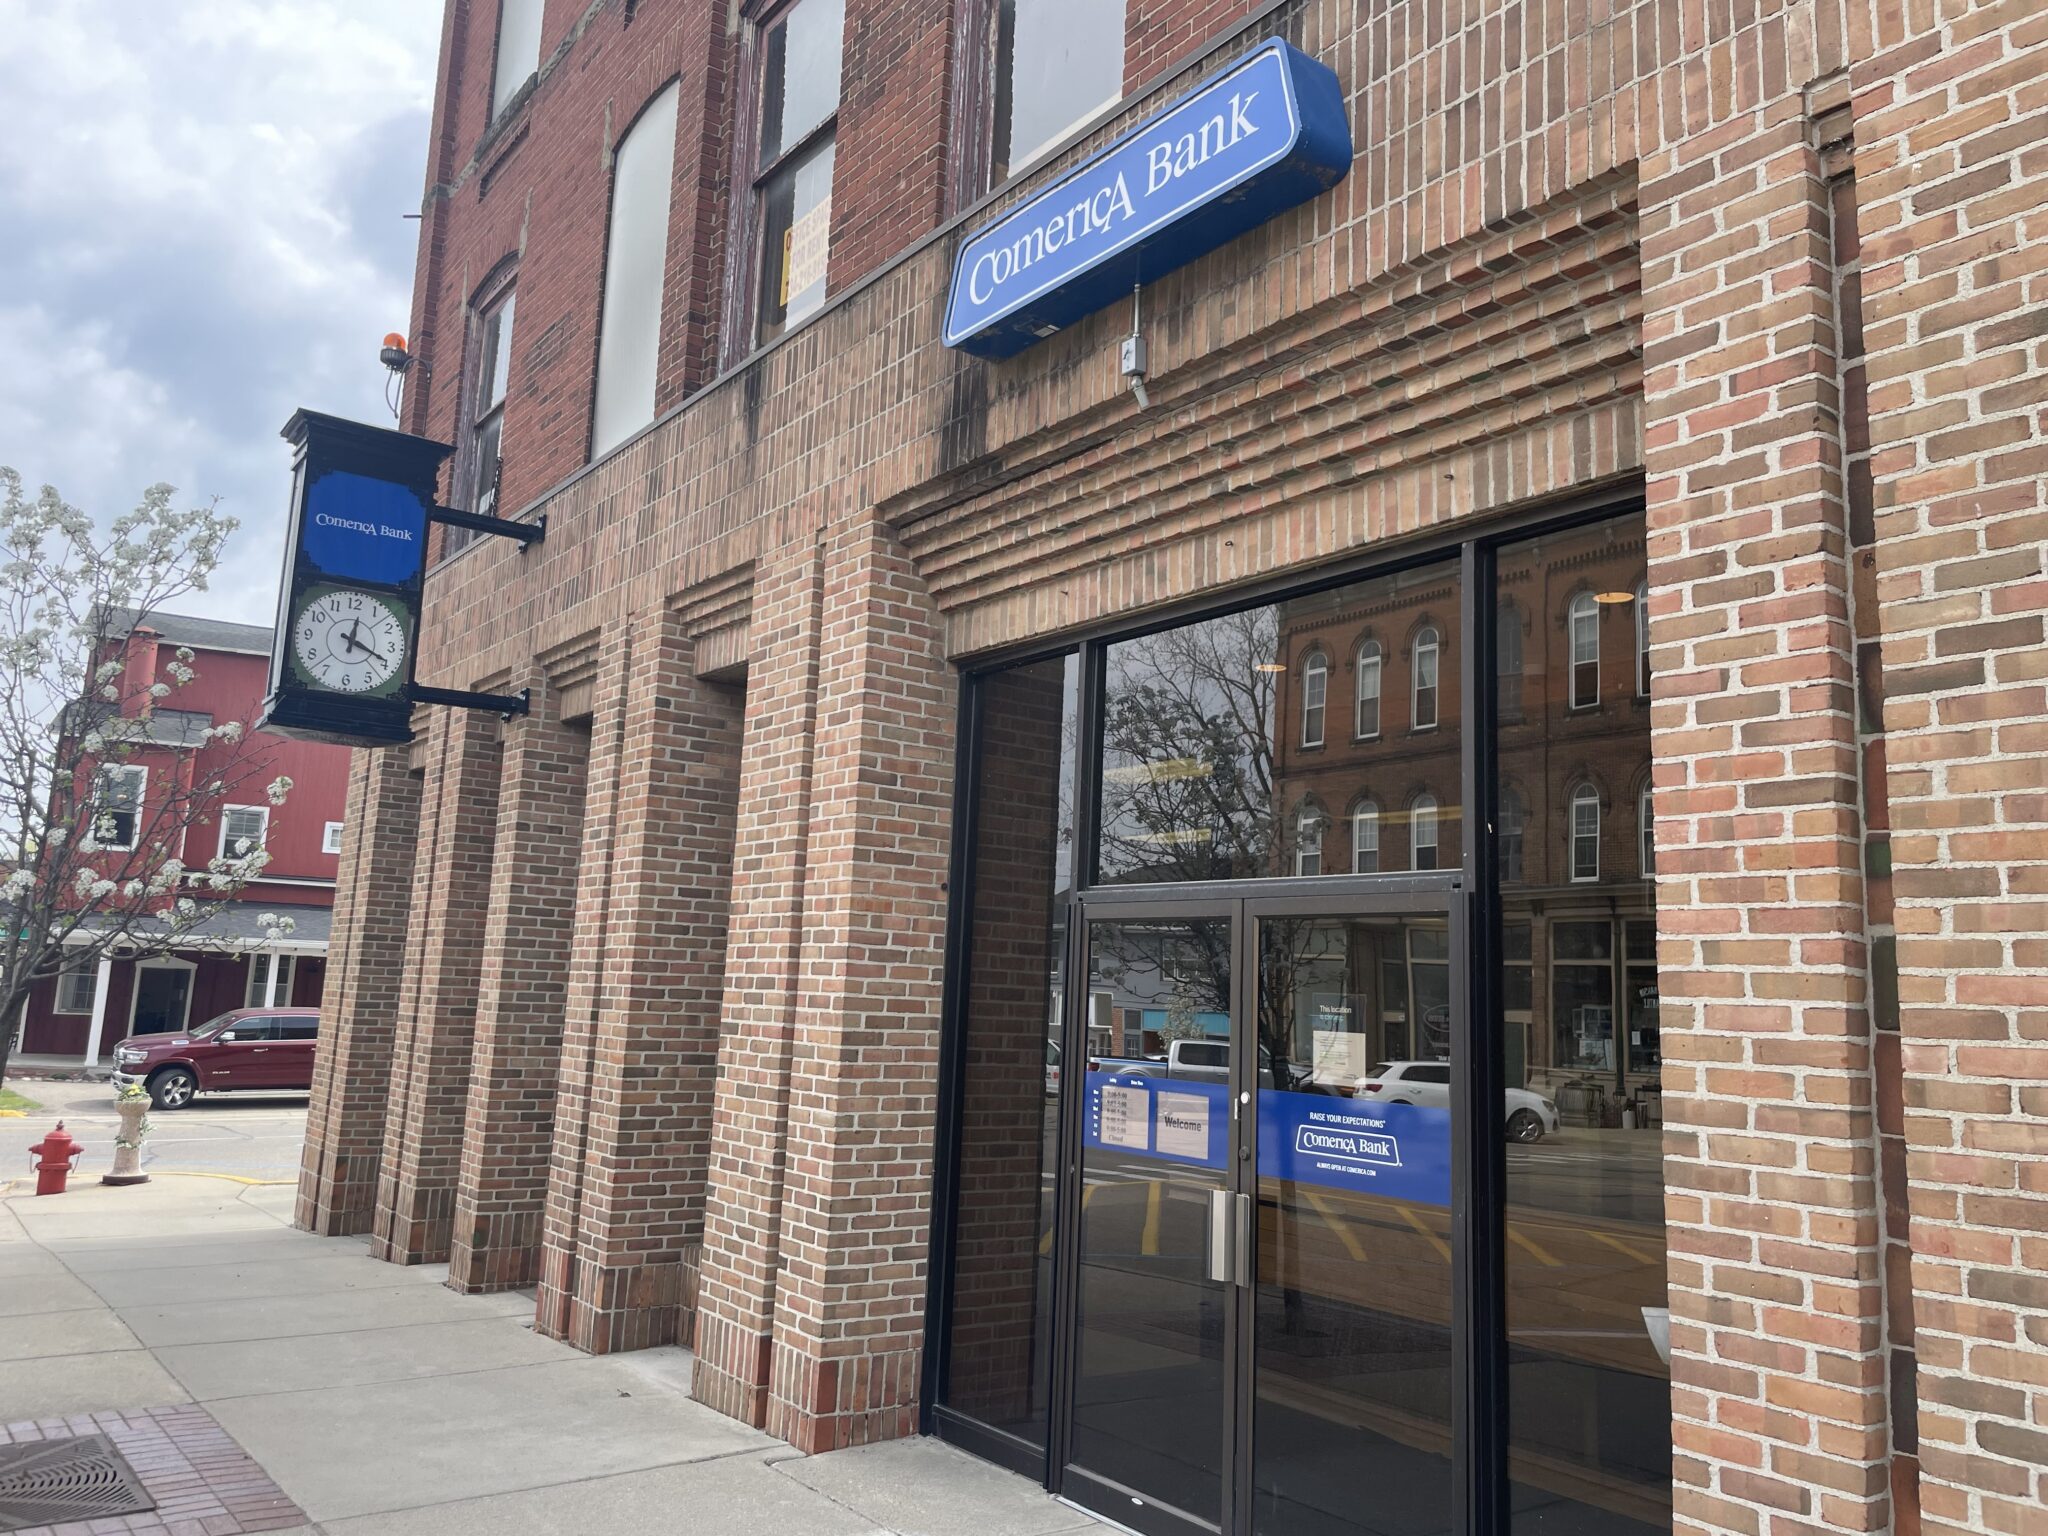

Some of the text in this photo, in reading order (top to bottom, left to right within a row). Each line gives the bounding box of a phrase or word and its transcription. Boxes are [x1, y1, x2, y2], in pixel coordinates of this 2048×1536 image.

[1144, 91, 1260, 198] Bank
[379, 525, 413, 541] Bank
[330, 600, 340, 612] 11
[349, 597, 363, 611] 12
[311, 610, 326, 623] 10
[372, 606, 377, 618] 1
[304, 628, 313, 641] 9
[384, 622, 393, 635] 2
[387, 641, 396, 654] 3
[307, 648, 317, 661] 8
[322, 664, 331, 677] 7
[380, 658, 389, 670] 4
[341, 674, 351, 686] 6
[363, 671, 372, 684] 5
[1320, 1004, 1352, 1014] This location
[1309, 1111, 1326, 1122] RAISE
[1326, 1113, 1342, 1123] YOUR
[1164, 1116, 1202, 1132] Welcome
[1358, 1138, 1391, 1157] Bank
